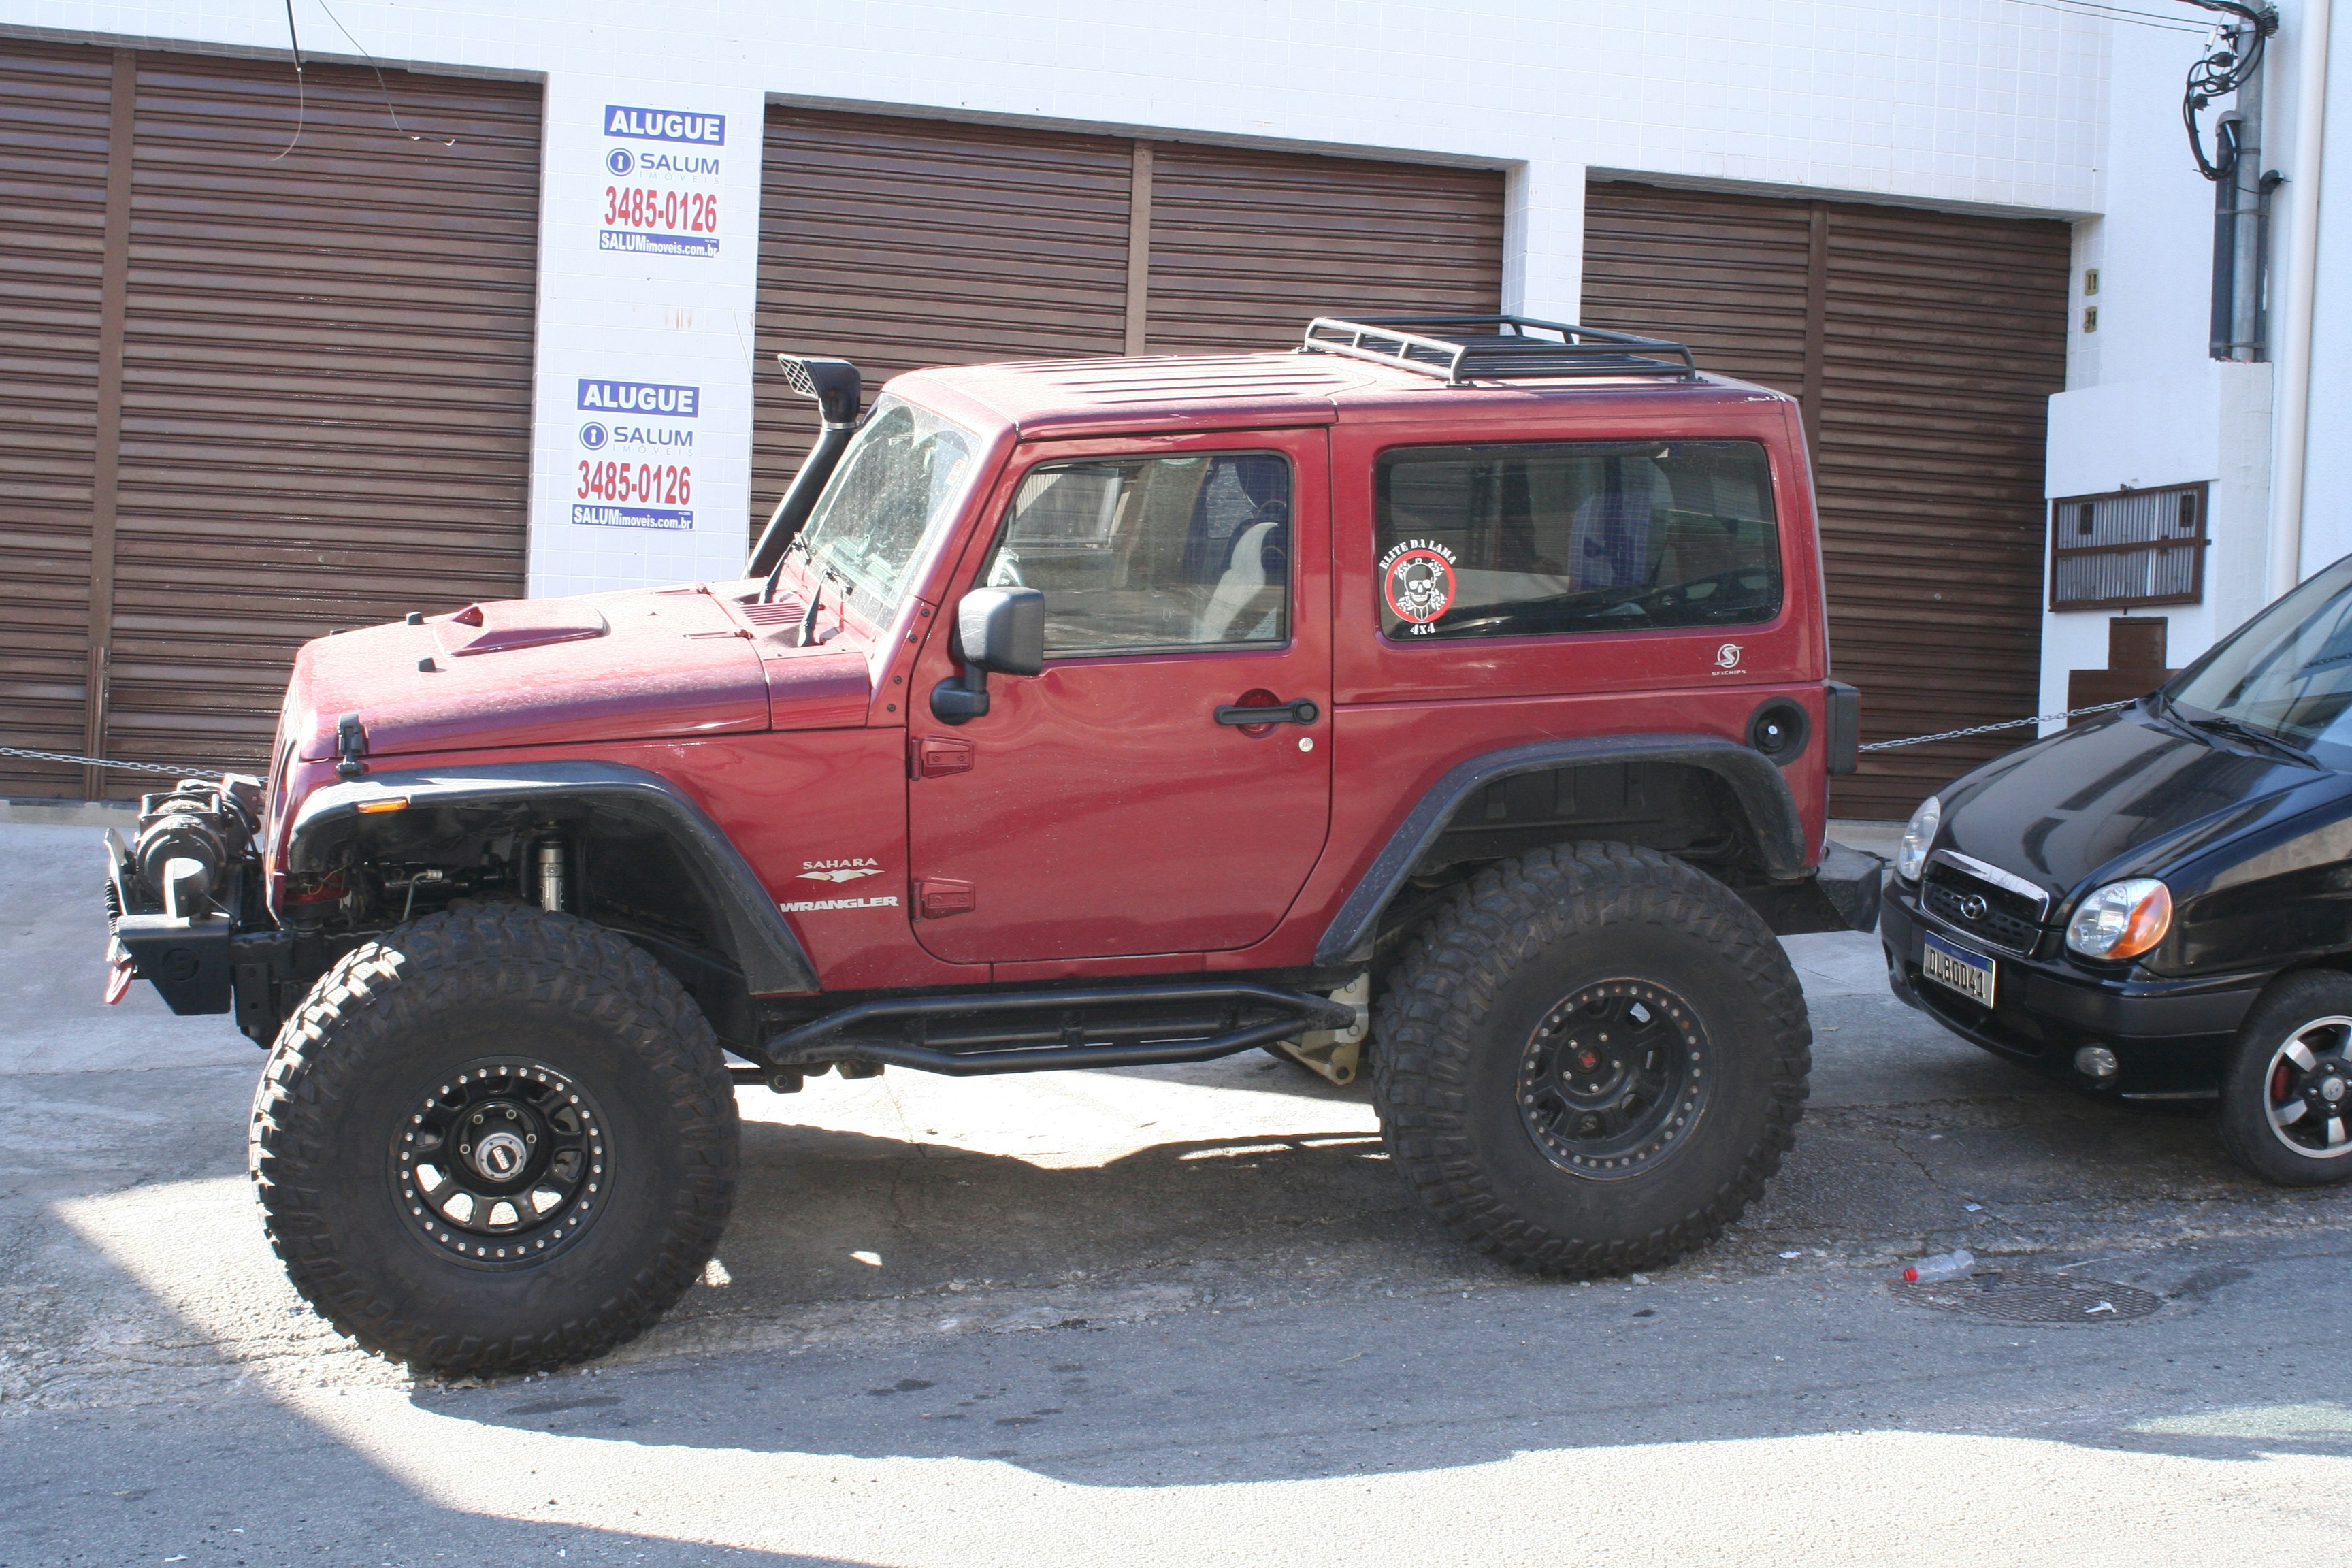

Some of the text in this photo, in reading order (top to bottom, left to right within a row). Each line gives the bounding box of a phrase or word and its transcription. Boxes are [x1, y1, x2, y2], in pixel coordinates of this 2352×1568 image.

[610, 110, 719, 141] ALUGUE
[640, 153, 719, 175] SALUM
[640, 172, 719, 184] IMÓVEIS
[604, 186, 717, 233] 3485-0126
[601, 232, 718, 257] SALUMimoveis.com.br
[583, 384, 693, 413] ALUGUE
[614, 426, 693, 447] SALUM
[612, 444, 693, 457] IMÓVEIS
[577, 459, 691, 505] 3485-0126
[574, 506, 691, 529] SALUMimoveis.com.br
[1379, 538, 1457, 570] ELITE DA LAMA
[1409, 622, 1436, 636] 4x4
[802, 857, 878, 870] SAHARA
[779, 896, 900, 912] WRANGLER
